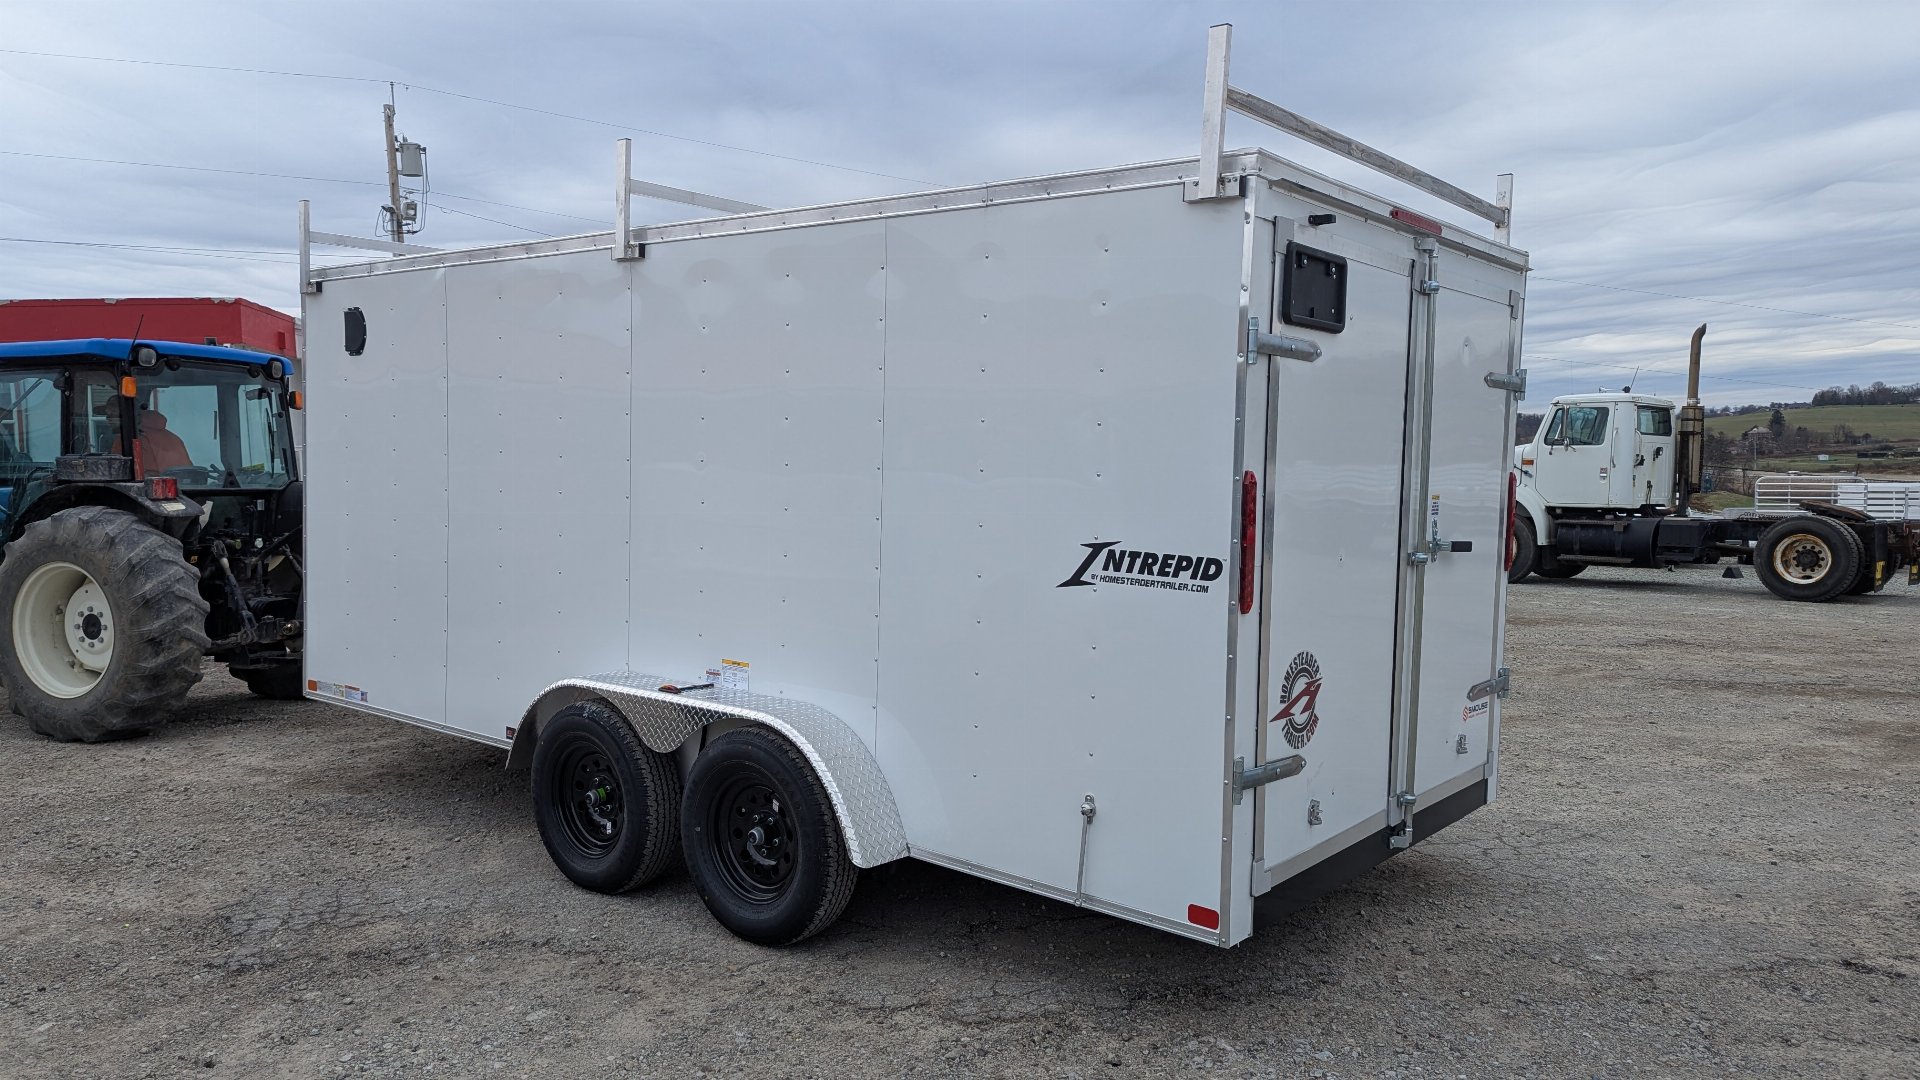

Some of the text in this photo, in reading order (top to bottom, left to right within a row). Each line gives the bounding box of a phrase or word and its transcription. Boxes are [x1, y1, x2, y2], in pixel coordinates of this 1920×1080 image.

[1056, 541, 1224, 588] INTREPID
[1091, 573, 1209, 593] BY HOMESTEADERTRAILER.COM
